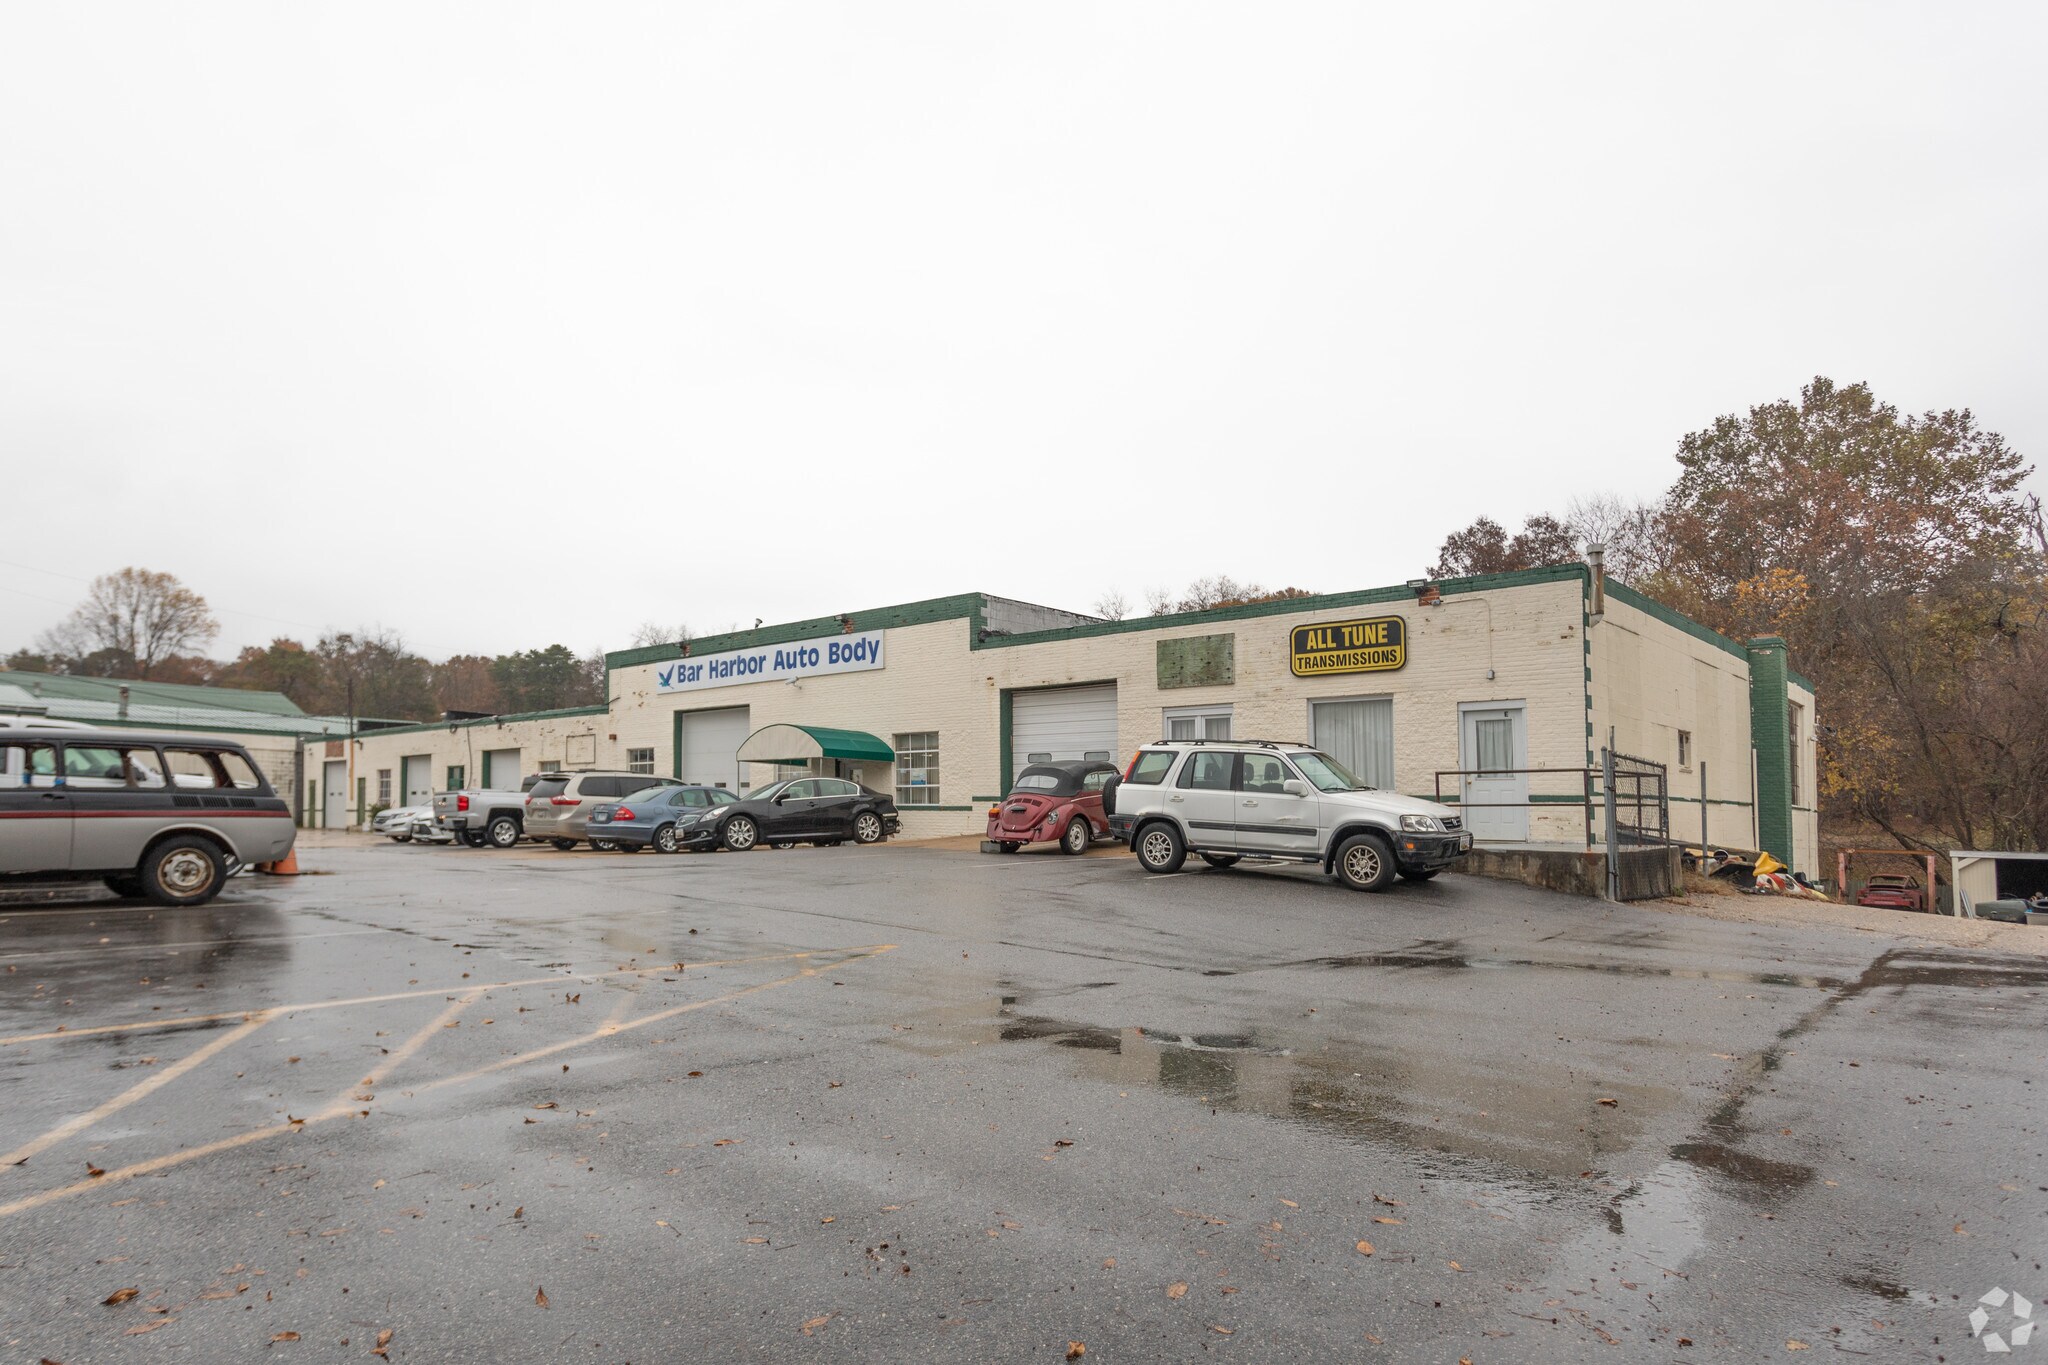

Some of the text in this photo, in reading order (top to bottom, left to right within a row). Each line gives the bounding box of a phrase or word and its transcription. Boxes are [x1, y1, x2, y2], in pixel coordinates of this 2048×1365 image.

[1307, 623, 1388, 650] ALL TUNE
[677, 637, 880, 683] Bar Harbor Auto Body
[1297, 649, 1397, 669] TRANSMISSIONS
